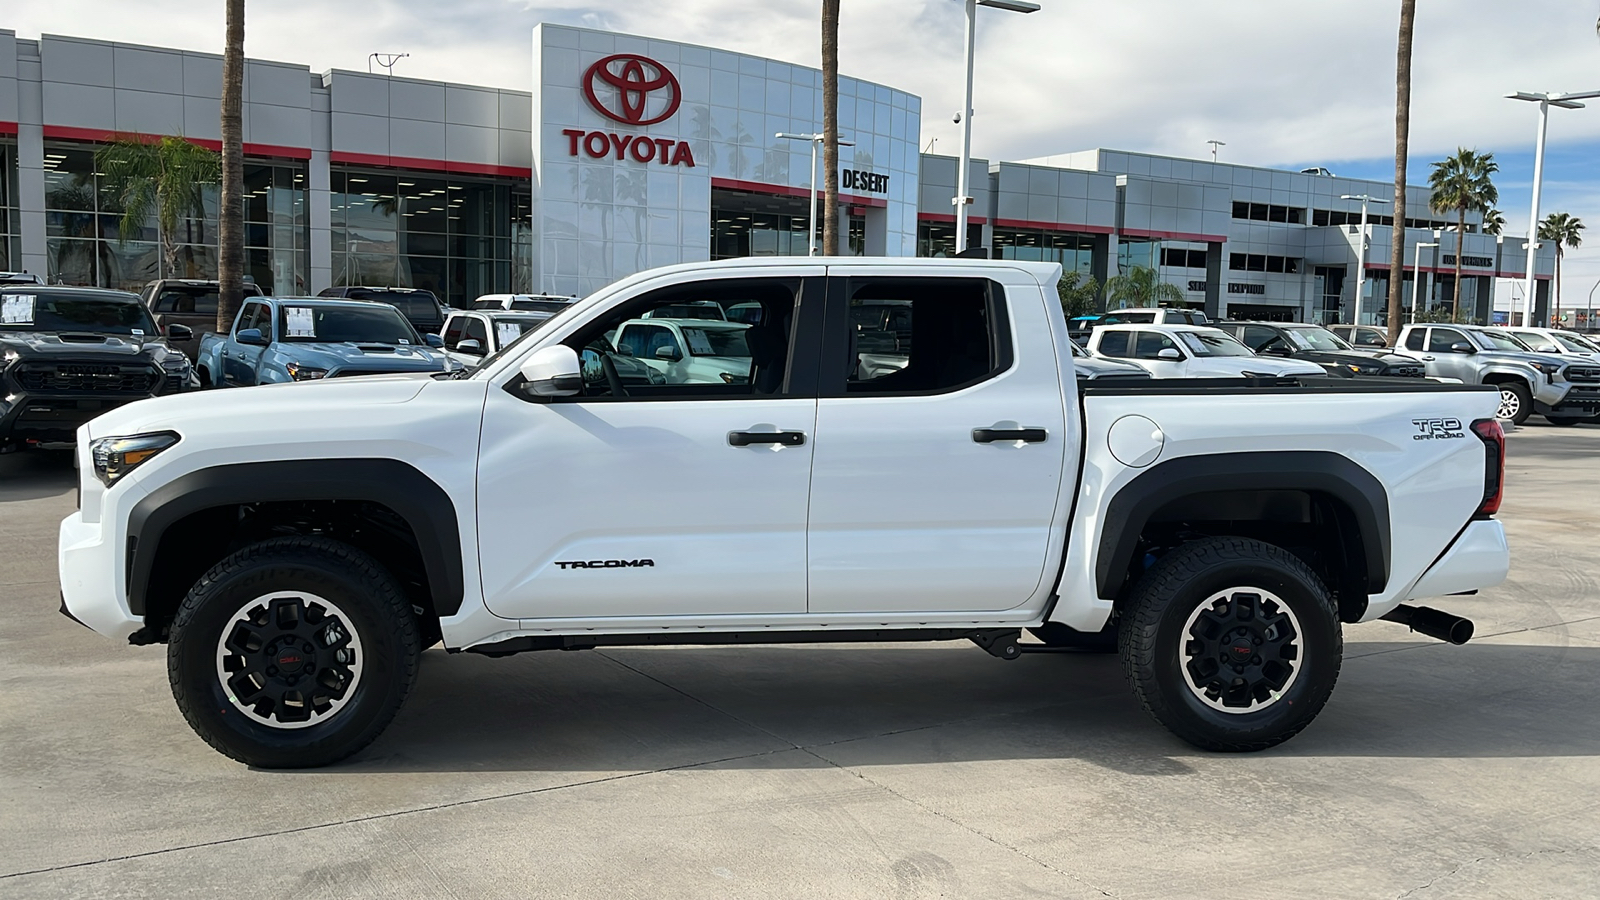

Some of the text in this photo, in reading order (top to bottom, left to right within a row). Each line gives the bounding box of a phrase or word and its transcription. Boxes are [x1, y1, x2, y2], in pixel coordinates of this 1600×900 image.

[562, 129, 696, 167] TOYOTA
[842, 168, 890, 194] DESERT
[1411, 417, 1462, 435] TRD
[1435, 432, 1466, 440] ROAD
[554, 559, 655, 570] TACOMA
[1233, 646, 1251, 654] TRD
